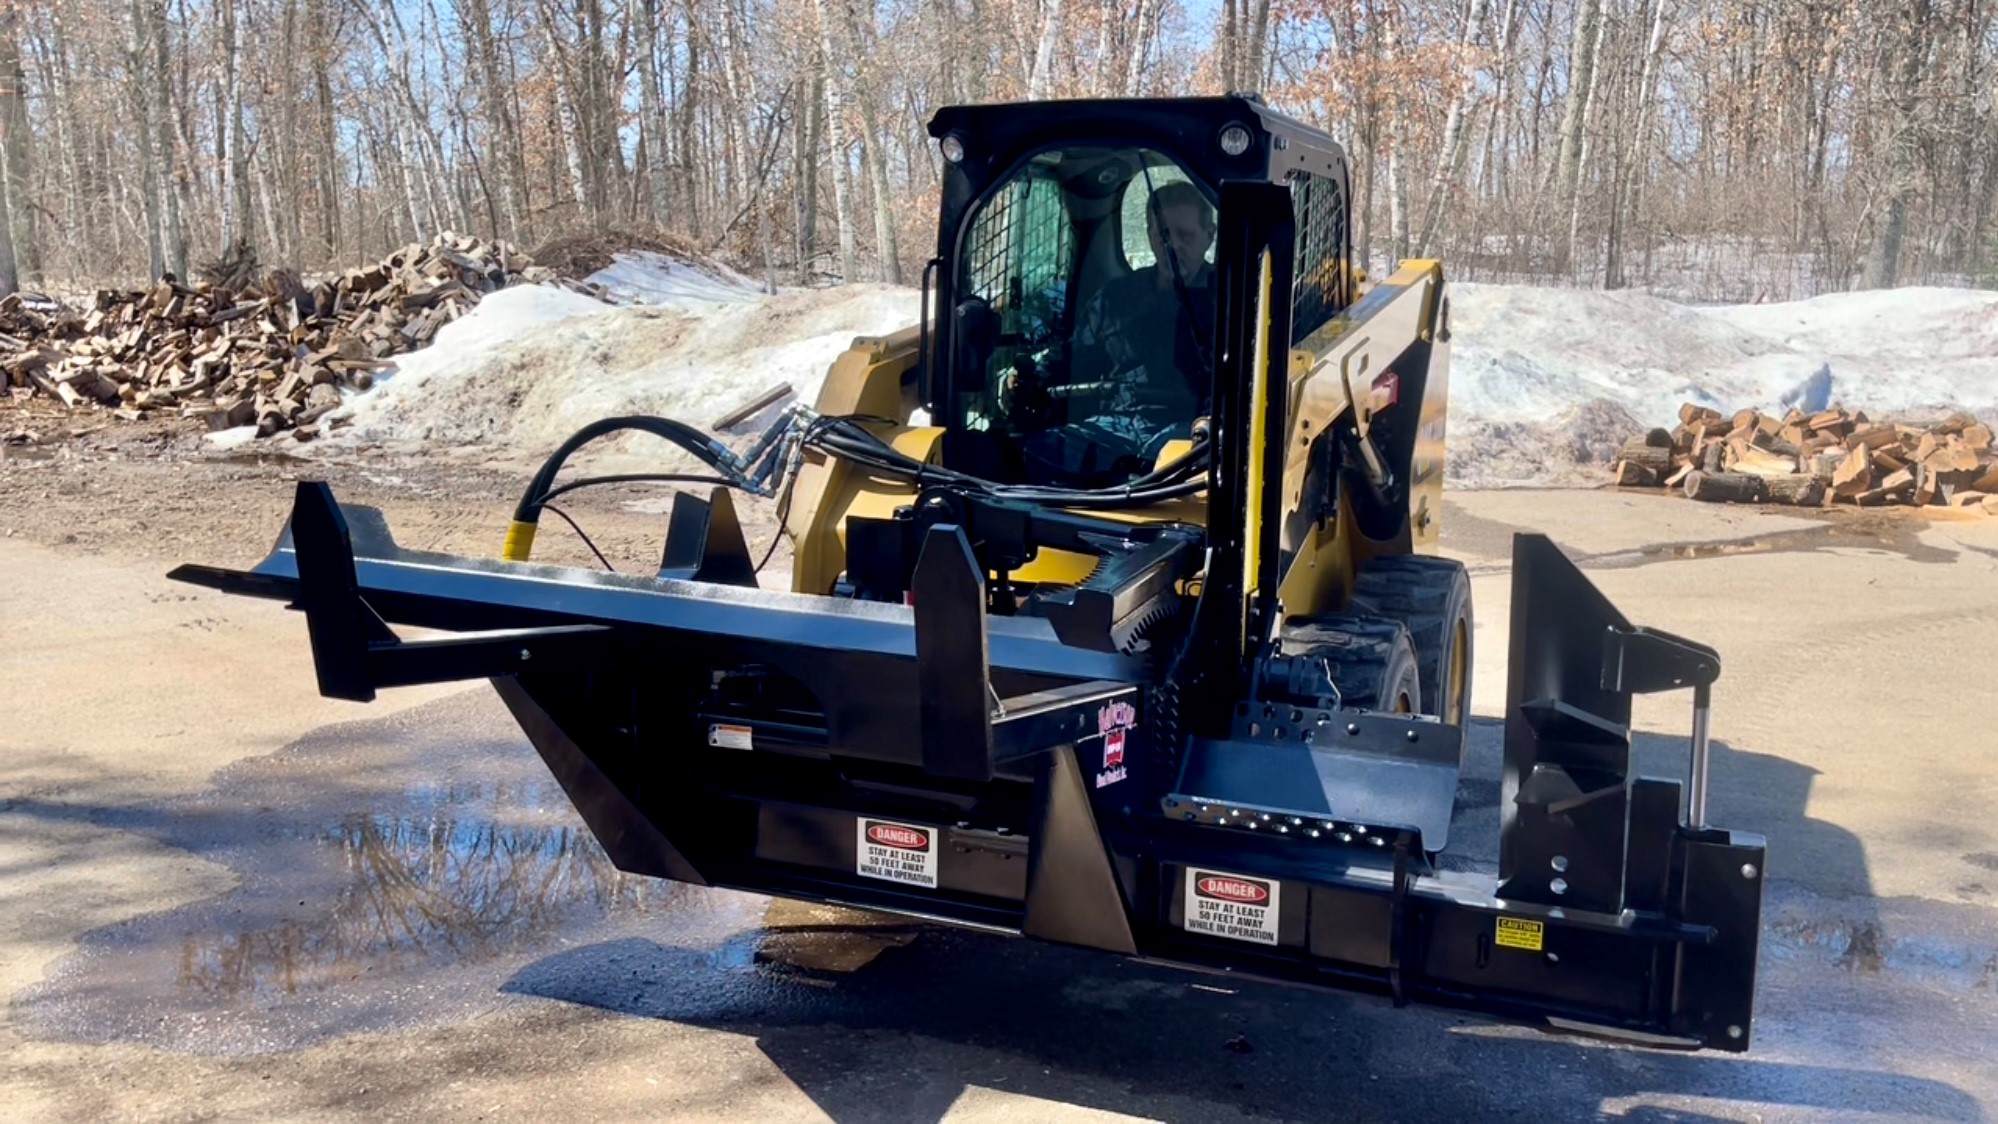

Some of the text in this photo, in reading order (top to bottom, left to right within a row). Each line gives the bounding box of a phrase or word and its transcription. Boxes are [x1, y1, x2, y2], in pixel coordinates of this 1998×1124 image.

[876, 827, 918, 844] DANGER
[868, 846, 925, 863] STAY AT LEAST
[869, 856, 924, 872] 50 FEET AWAY
[861, 864, 933, 884] WHILE IN OPERATION
[1208, 880, 1256, 898] DANGER
[1198, 900, 1265, 918] STAY AT LEAST
[1199, 911, 1264, 929] 50 FEET AWAY
[1188, 919, 1274, 941] WHILE IN OPERATION
